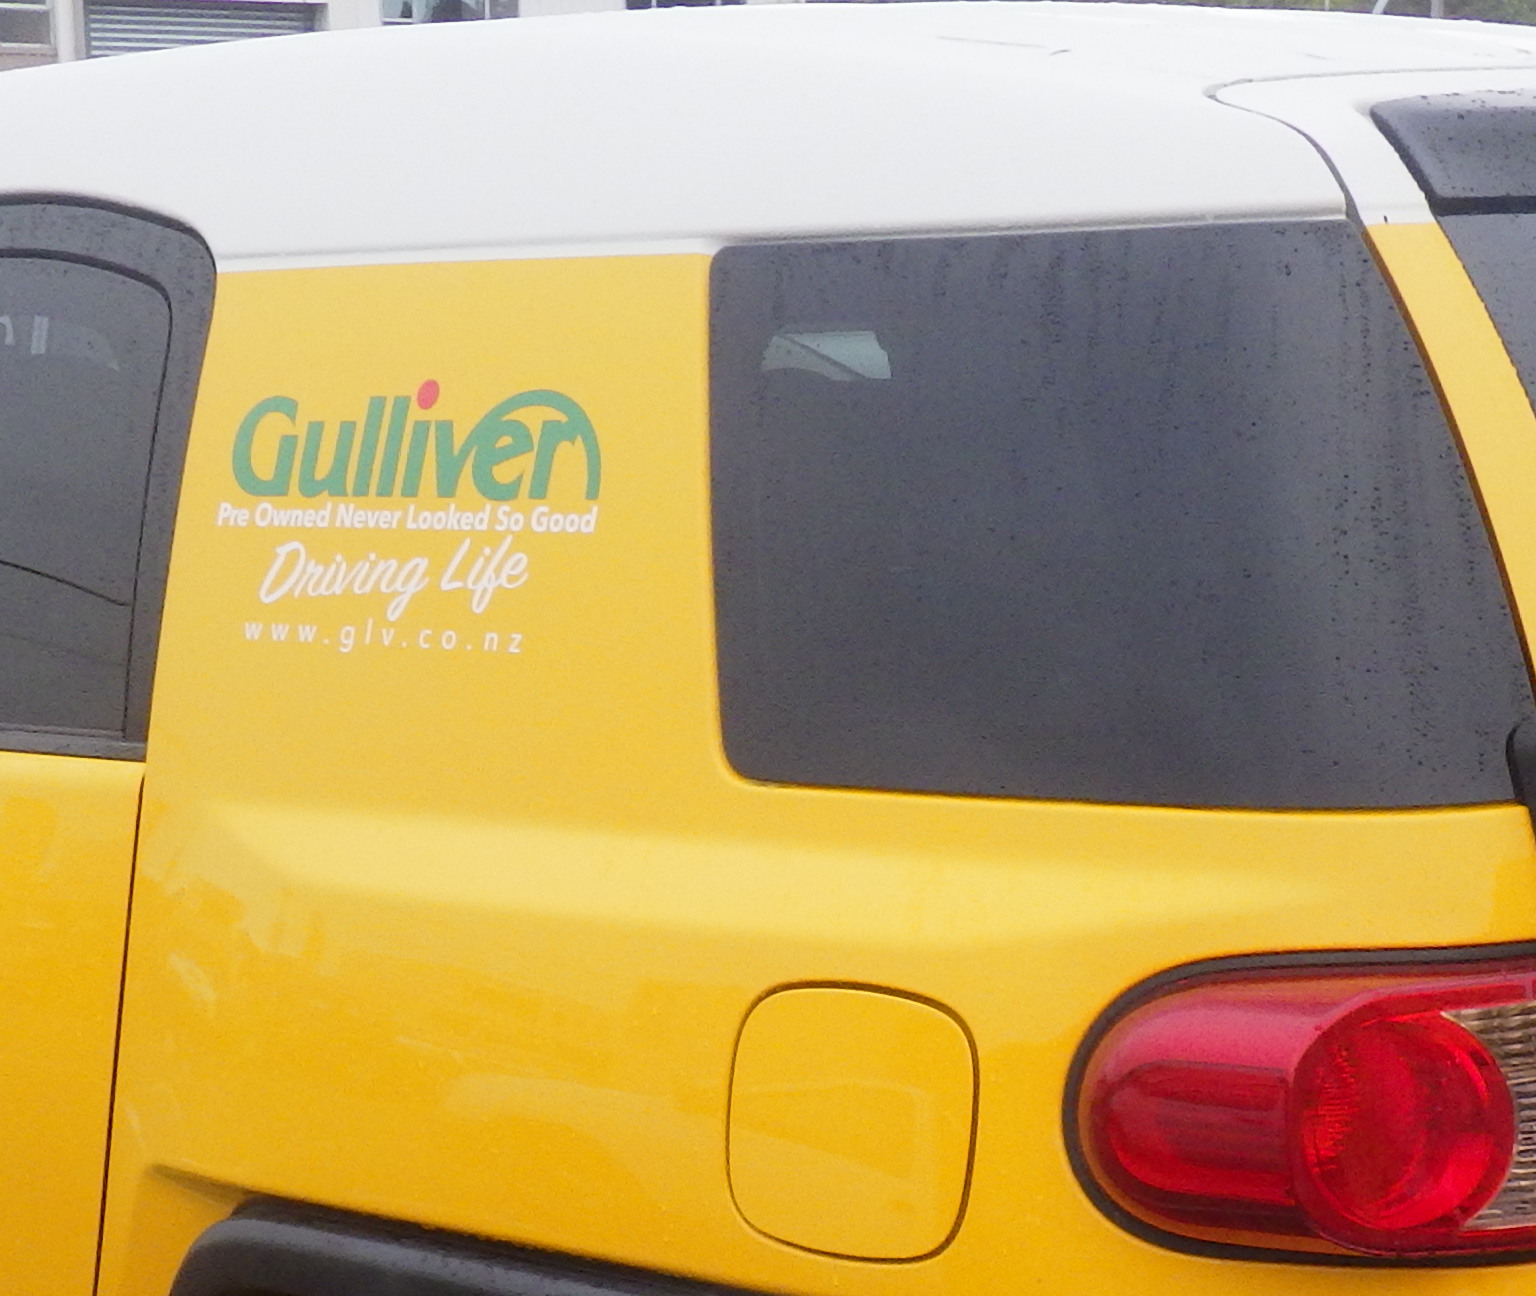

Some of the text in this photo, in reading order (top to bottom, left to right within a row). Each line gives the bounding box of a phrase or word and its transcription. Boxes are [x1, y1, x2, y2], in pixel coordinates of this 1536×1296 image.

[232, 379, 601, 501] Gulliver
[217, 502, 598, 534] Pre Owned Never Looked So Good
[259, 534, 529, 622] Driving Life
[244, 617, 523, 654] www.glv.co.nz
